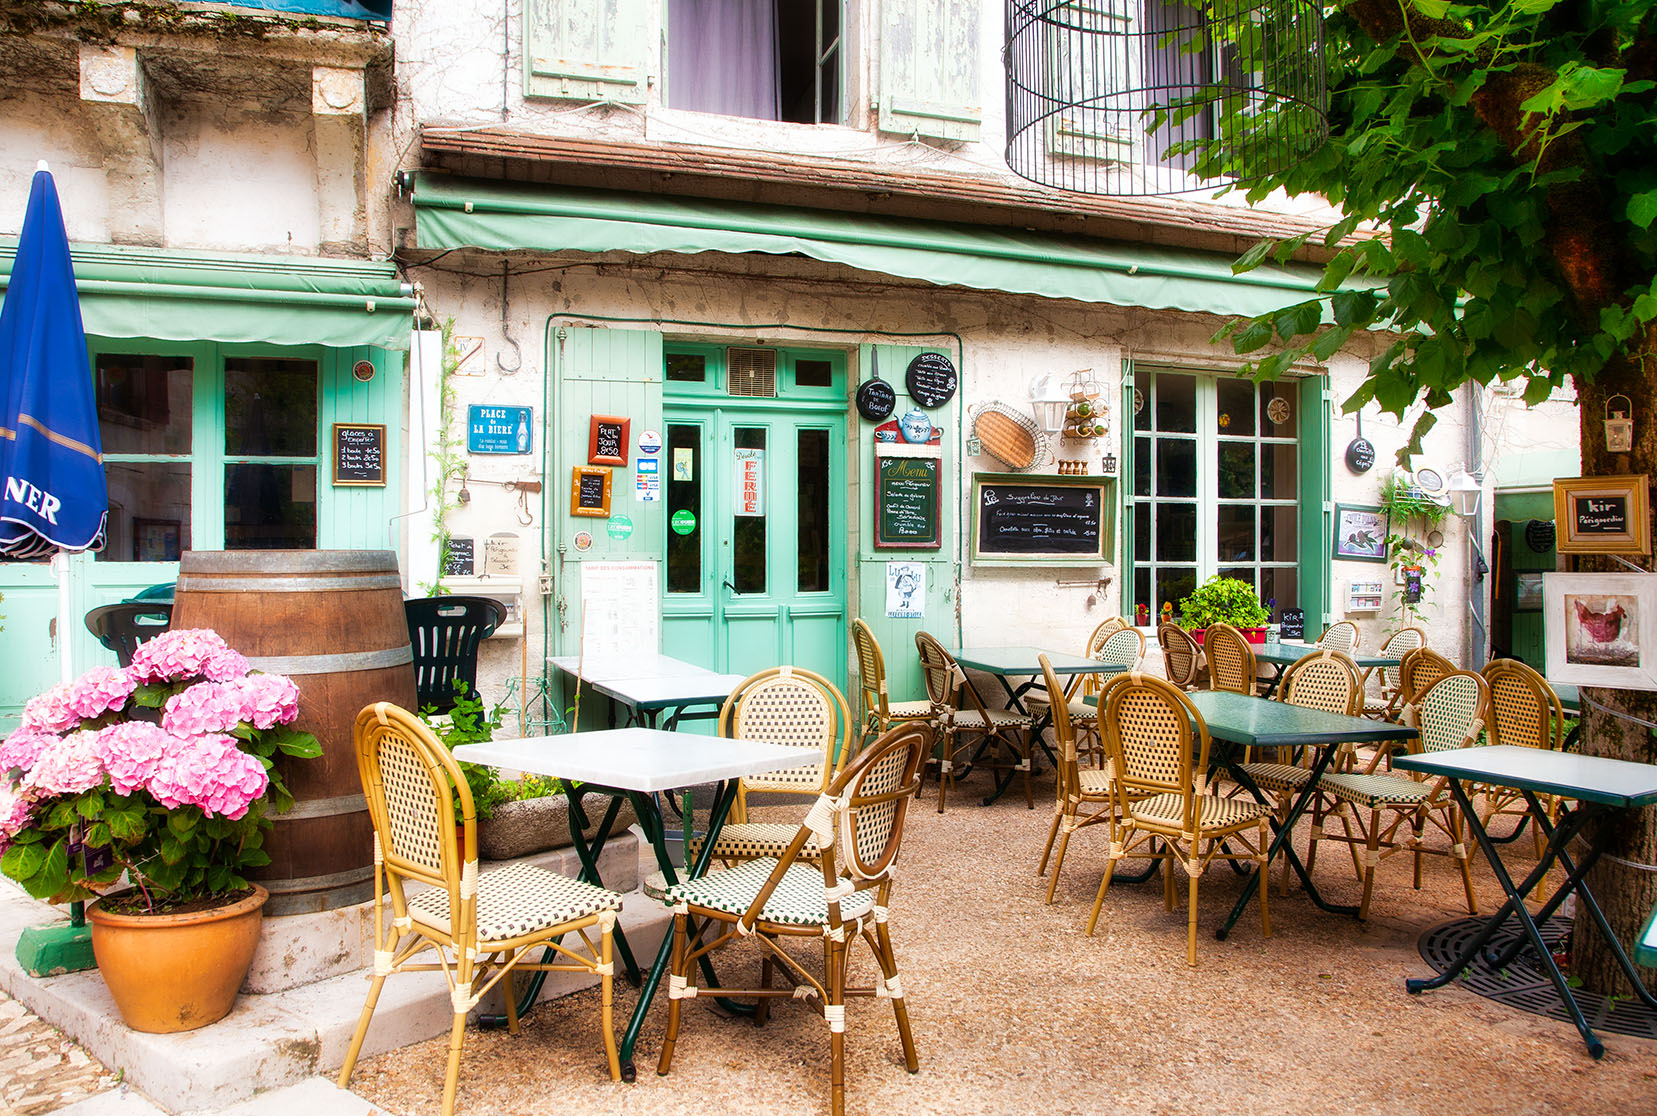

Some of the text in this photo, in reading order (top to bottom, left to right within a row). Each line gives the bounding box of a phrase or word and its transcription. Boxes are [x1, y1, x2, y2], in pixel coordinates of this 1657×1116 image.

[480, 409, 506, 419] PLACE
[473, 424, 484, 434] LA
[598, 438, 617, 447] JOUR
[887, 460, 929, 477] Menu
[744, 461, 757, 513] FERMÉ
